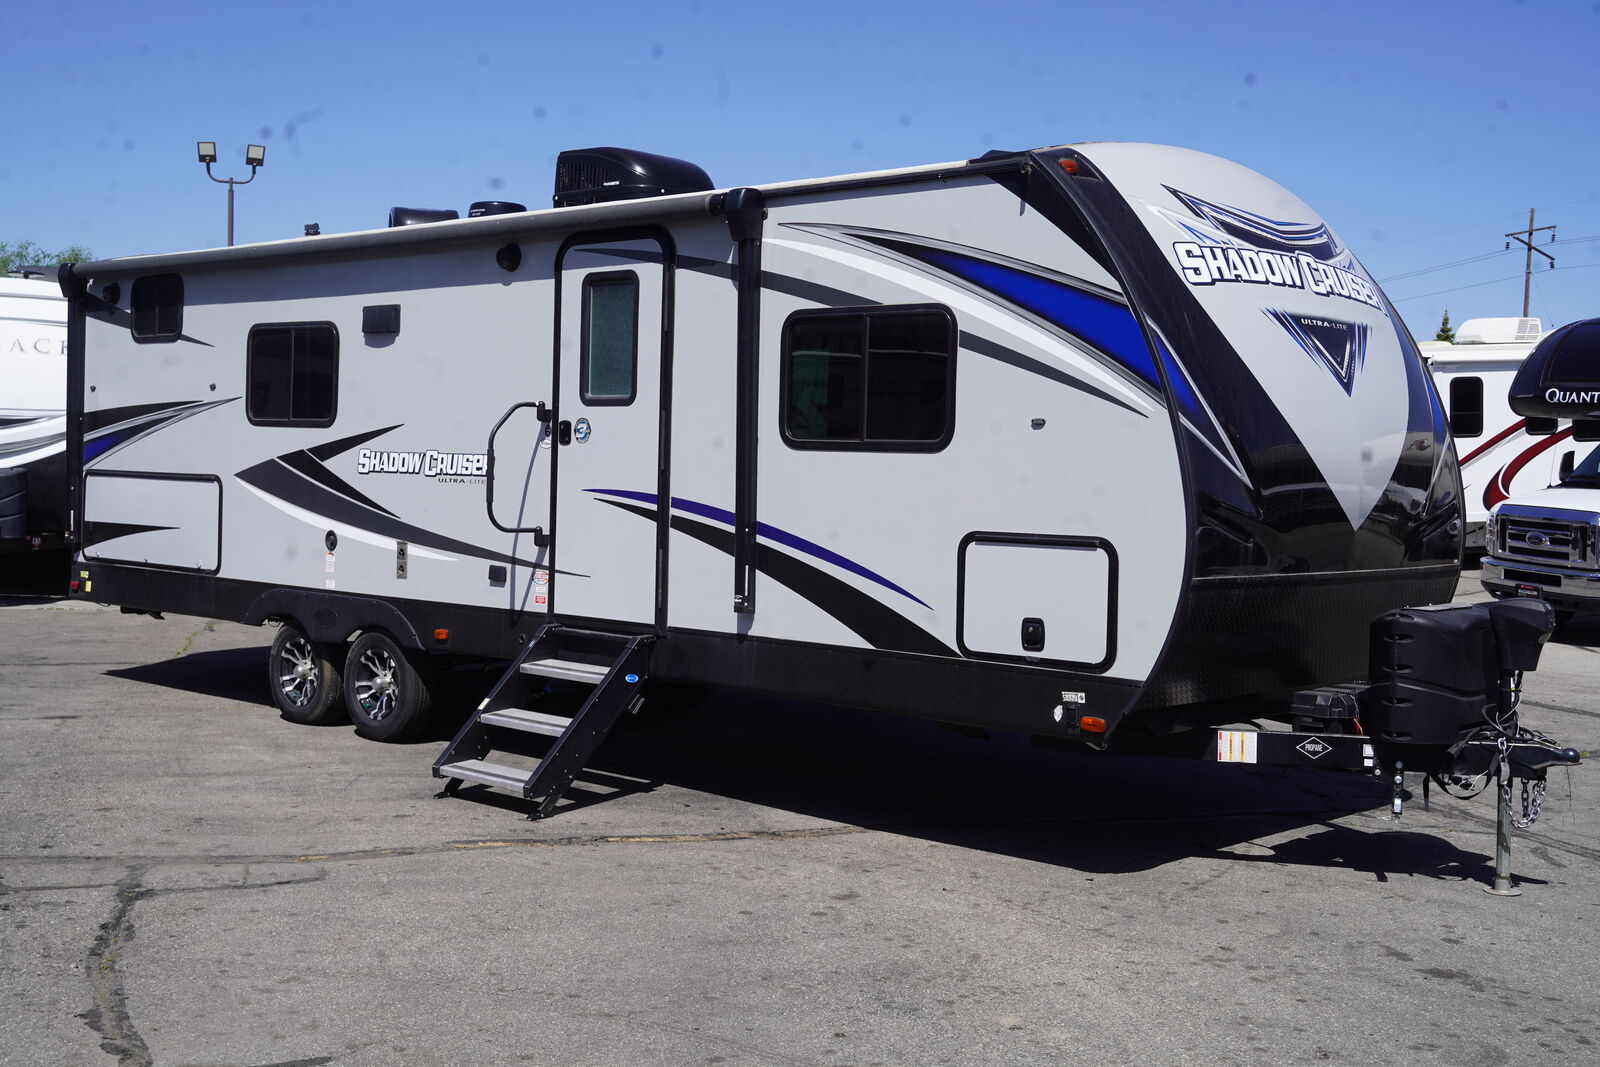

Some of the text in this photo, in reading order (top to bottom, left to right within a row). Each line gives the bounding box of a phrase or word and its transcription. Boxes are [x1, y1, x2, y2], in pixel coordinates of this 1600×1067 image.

[1173, 242, 1389, 318] SHADOW CRUISER
[1301, 318, 1348, 330] ULTRA-LITE
[1545, 388, 1600, 403] QUANT
[357, 449, 424, 475] SHADOW
[438, 477, 487, 485] ULTRA-LITE
[1305, 743, 1323, 752] PROPANE
